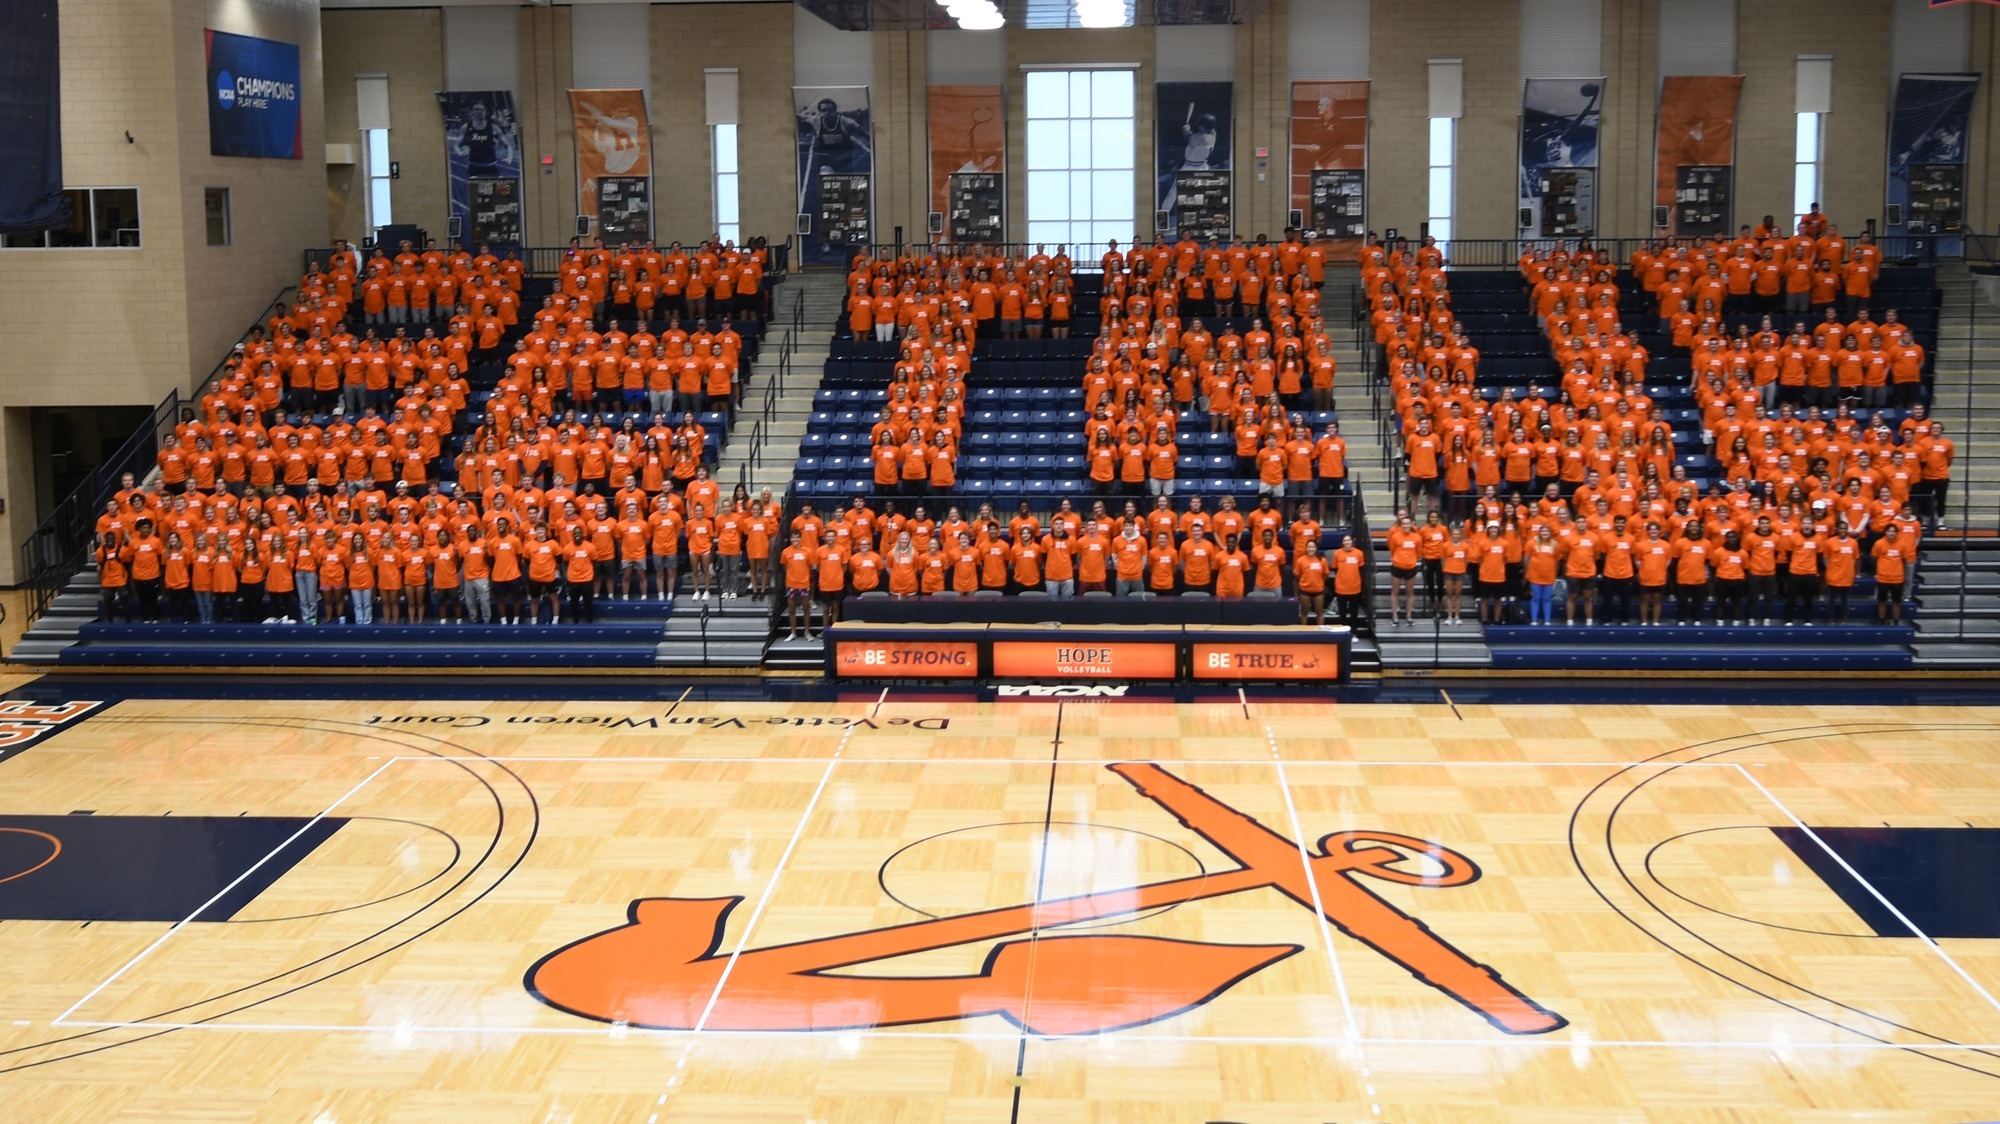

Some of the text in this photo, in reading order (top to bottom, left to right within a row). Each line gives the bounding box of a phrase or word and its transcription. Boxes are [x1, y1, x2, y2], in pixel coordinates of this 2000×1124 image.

[218, 88, 235, 101] NCAA
[236, 76, 295, 101] CHAMPIONS
[238, 97, 268, 110] PLAY HERE
[850, 233, 857, 242] 2
[1387, 230, 1396, 239] 3
[864, 649, 971, 667] BE STRONG.
[1056, 647, 1112, 664] HOPE
[1208, 652, 1299, 669] BE TRUE.
[1057, 666, 1112, 674] VOLLEYBALL
[998, 685, 1129, 697] NCAA
[364, 714, 491, 728] Court
